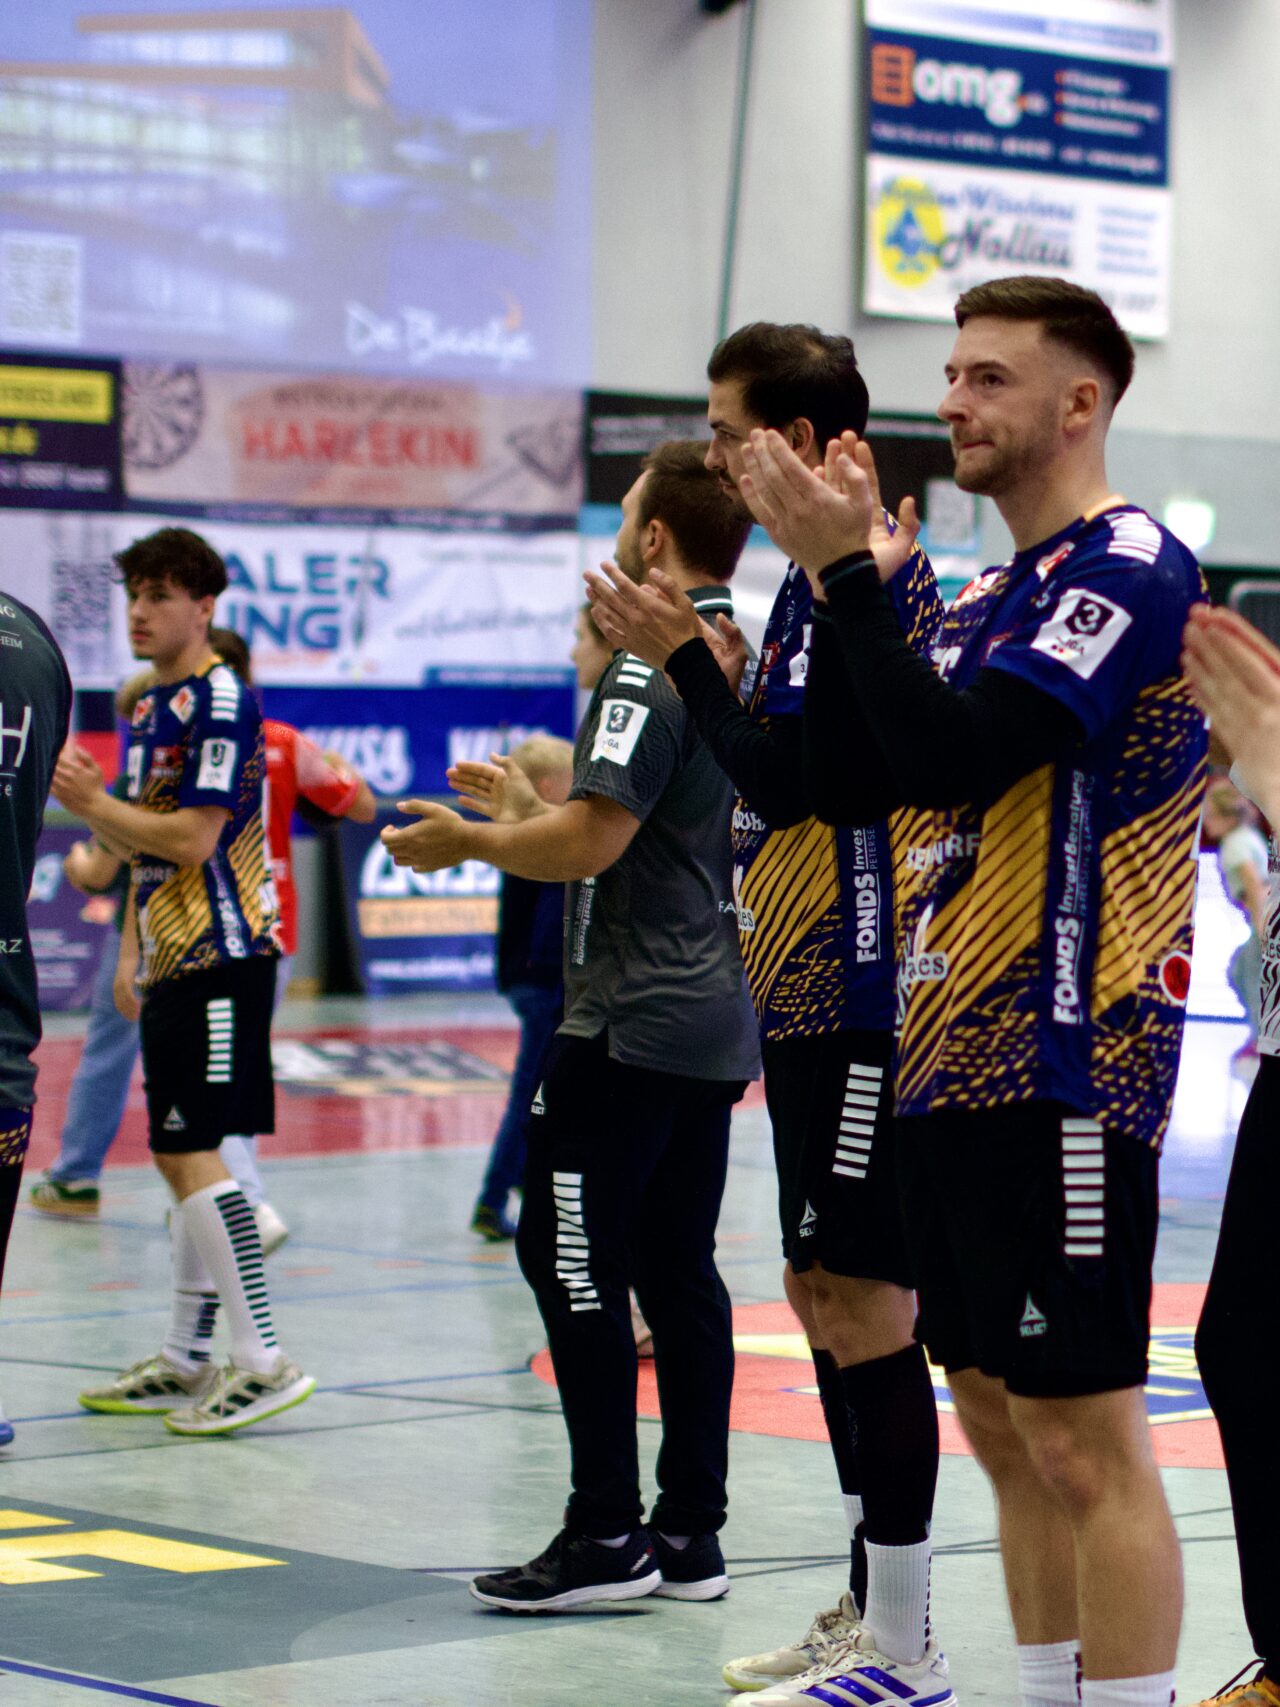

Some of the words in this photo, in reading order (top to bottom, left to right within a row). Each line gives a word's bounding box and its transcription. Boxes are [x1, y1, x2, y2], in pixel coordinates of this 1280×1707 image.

[242, 418, 479, 470] HARLEKIN
[1058, 768, 1085, 913] InvestBeratung
[854, 872, 878, 964] FONDS
[1053, 917, 1081, 1024] FONDS
